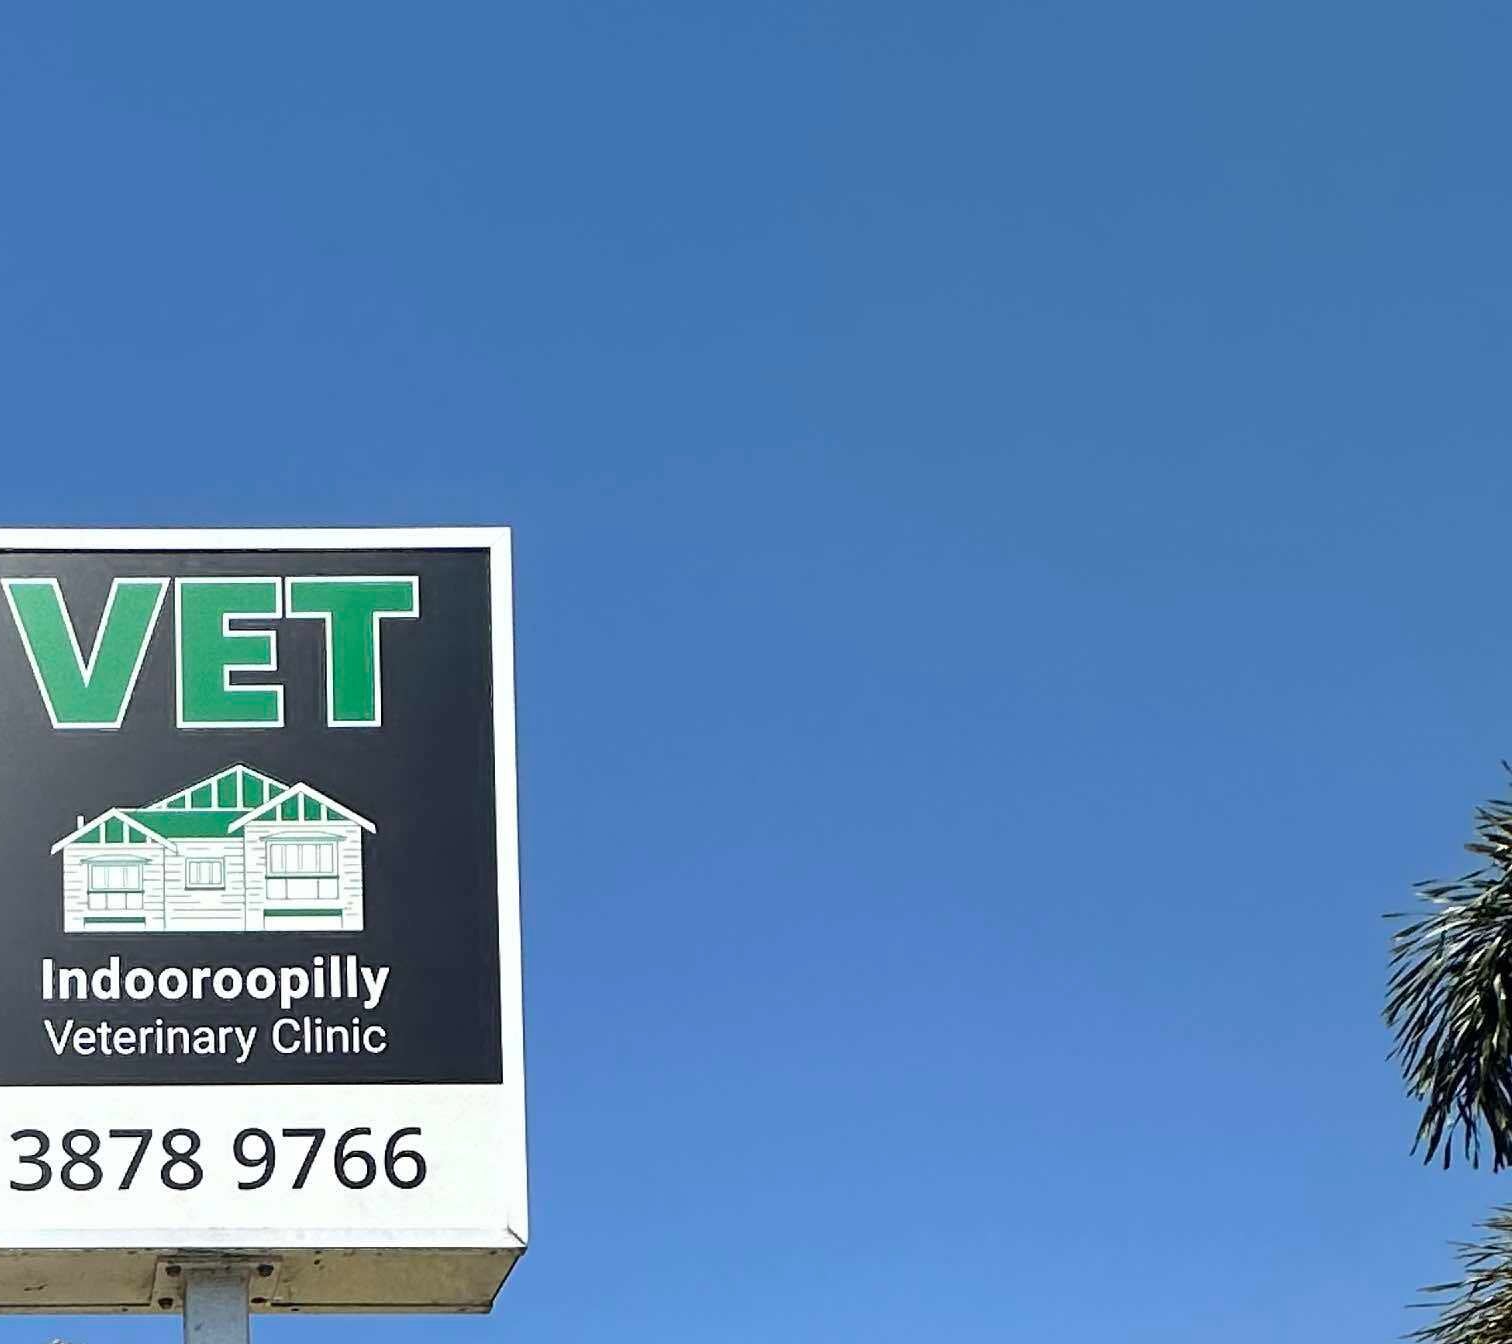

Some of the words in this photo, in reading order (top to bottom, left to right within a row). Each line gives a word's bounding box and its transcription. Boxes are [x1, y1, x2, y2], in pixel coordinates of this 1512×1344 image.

[0, 576, 419, 729] VET
[42, 955, 390, 1009] Indooroopilly
[44, 1018, 257, 1063] Veterinary
[272, 1017, 387, 1055] Clinic
[10, 1128, 203, 1191] 3878
[232, 1127, 427, 1190] 9766
